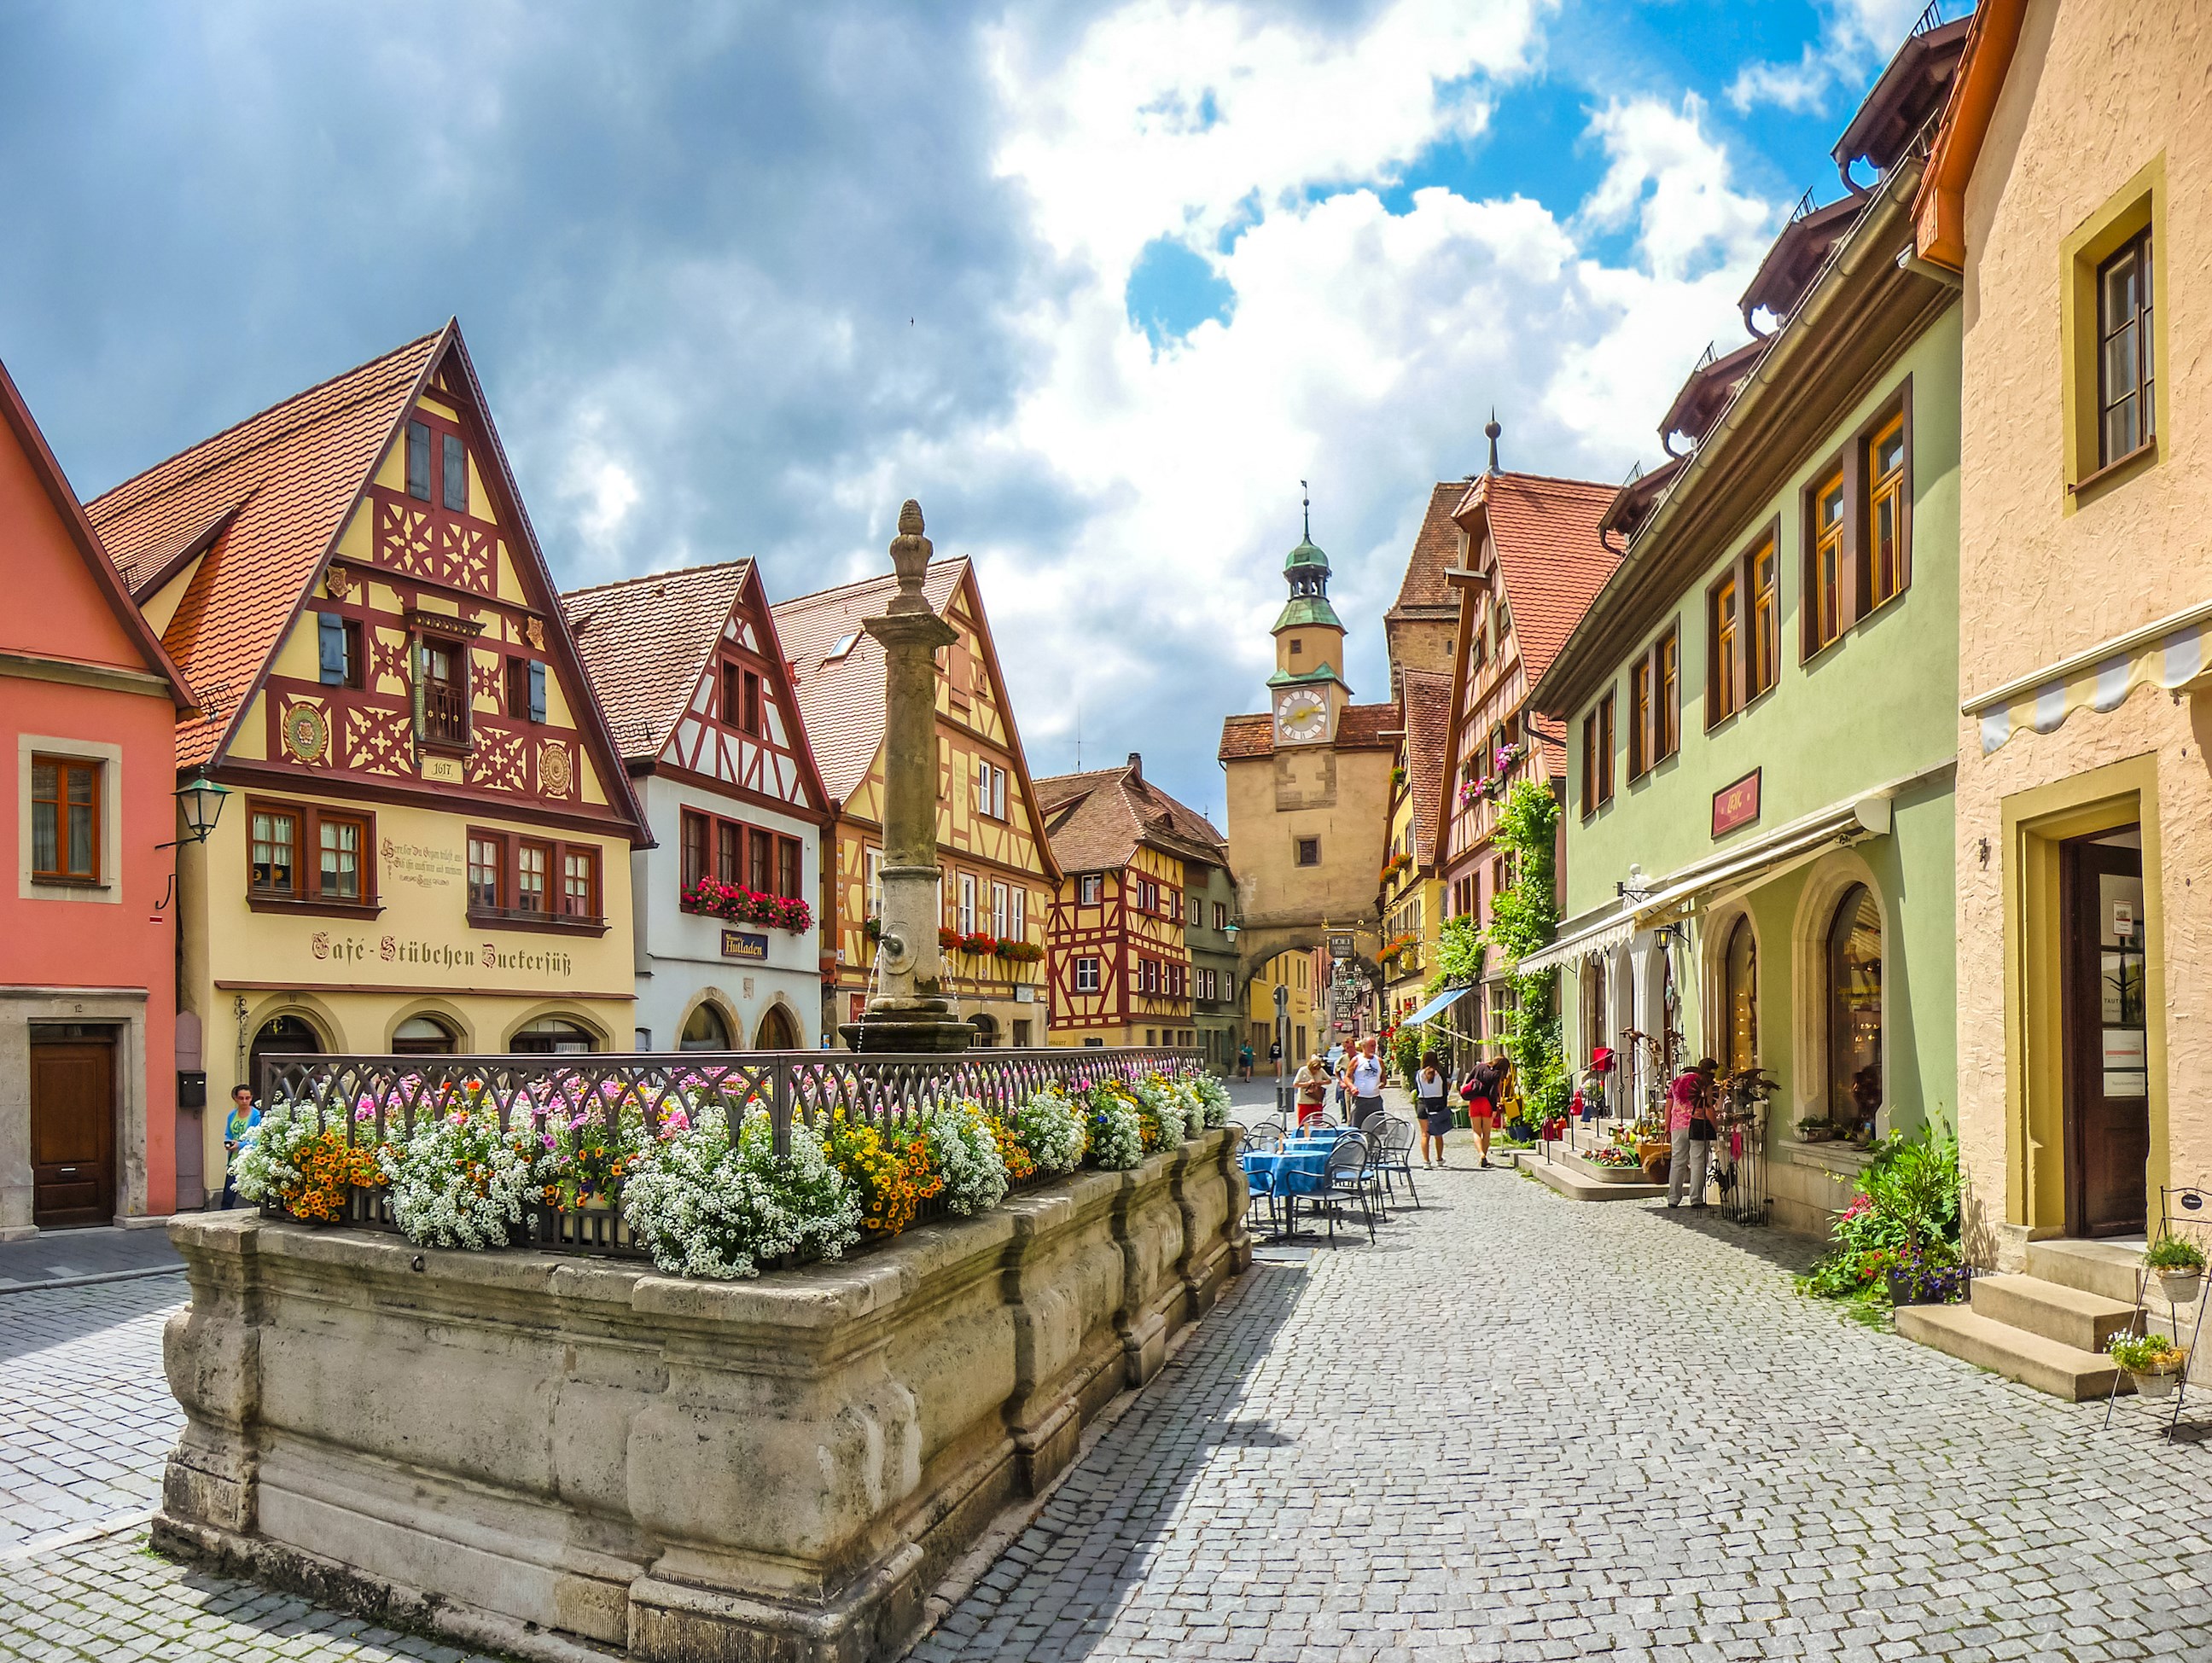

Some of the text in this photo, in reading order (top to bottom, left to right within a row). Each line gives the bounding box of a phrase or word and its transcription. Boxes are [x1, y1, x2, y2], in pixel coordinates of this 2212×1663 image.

[432, 762, 452, 776] 1617
[380, 936, 474, 971] Stübchen
[74, 1003, 82, 1013] 12
